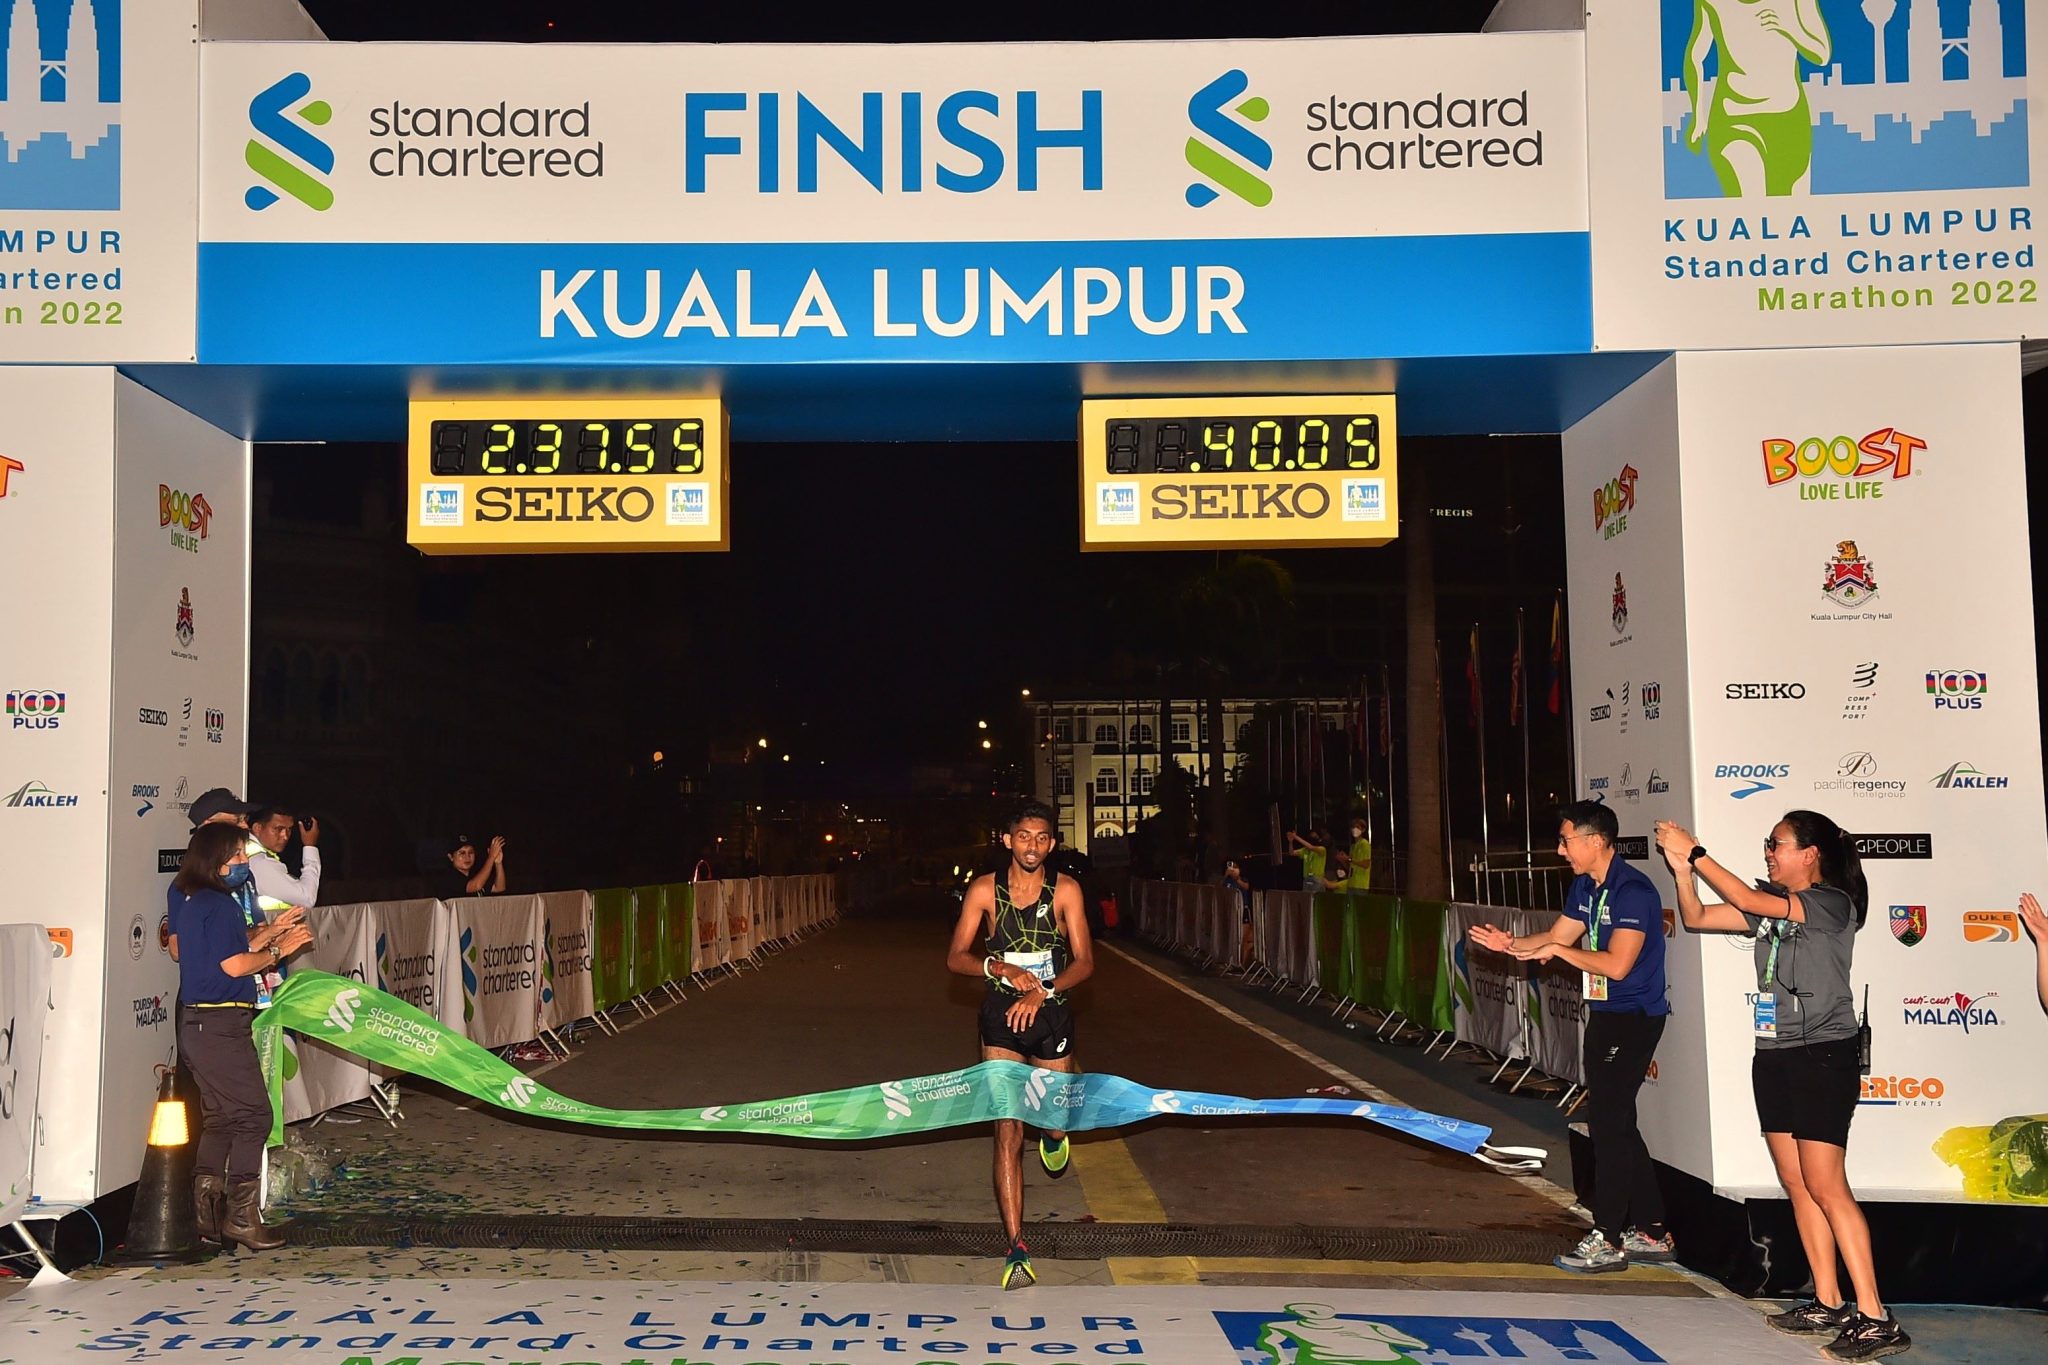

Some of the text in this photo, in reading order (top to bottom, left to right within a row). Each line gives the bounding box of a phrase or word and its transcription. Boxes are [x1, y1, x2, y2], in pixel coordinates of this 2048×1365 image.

[369, 100, 590, 137] standard
[1307, 90, 1528, 131] standard
[685, 90, 1103, 195] FINISH
[1307, 131, 1543, 172] chartered
[369, 140, 603, 178] chartered
[1664, 207, 2034, 243] KUALA LUMPUR
[1664, 244, 2035, 280] Standard Chartered
[540, 266, 1248, 338] KUALA LUMPUR
[1758, 279, 2038, 311] Marathon 2022
[40, 301, 122, 324] 2022
[1762, 427, 1928, 487] BOOST
[1152, 482, 1330, 520] SEIKO
[1593, 463, 1639, 531] BOOST
[1800, 481, 1884, 500] LOVE LIFE
[158, 484, 213, 539] BOOST
[475, 486, 654, 522] SEIKO
[1436, 508, 1473, 517] REGIS
[1811, 612, 1893, 622] Kuala Lumpur City Hall
[1726, 682, 1806, 700] SEIKO
[1930, 670, 1983, 697] 100
[10, 690, 61, 716] 100
[1644, 707, 1660, 720] PLUS
[1935, 697, 1983, 709] PLUS
[13, 717, 60, 729] PLUS
[139, 707, 168, 727] SEIKO
[207, 731, 222, 743] PLUS
[1714, 764, 1790, 778] BROOKS
[1951, 776, 2009, 789] AKLEH
[23, 795, 78, 807] AKLEH
[132, 784, 160, 798] BROOKS
[393, 950, 434, 982] standard
[483, 939, 535, 969] standard
[482, 969, 535, 995] chartere
[136, 1006, 168, 1031] MALAYSIA
[368, 1007, 440, 1042] standard
[1904, 1008, 1998, 1034] MALAYSIA
[365, 1019, 438, 1056] chartered
[916, 1082, 971, 1102] chartered
[1861, 1076, 1944, 1099] RiGO
[738, 1098, 808, 1120] standard
[131, 1309, 1140, 1331] KUALA LUMPUR
[82, 1331, 1145, 1355] Standard Chartered
